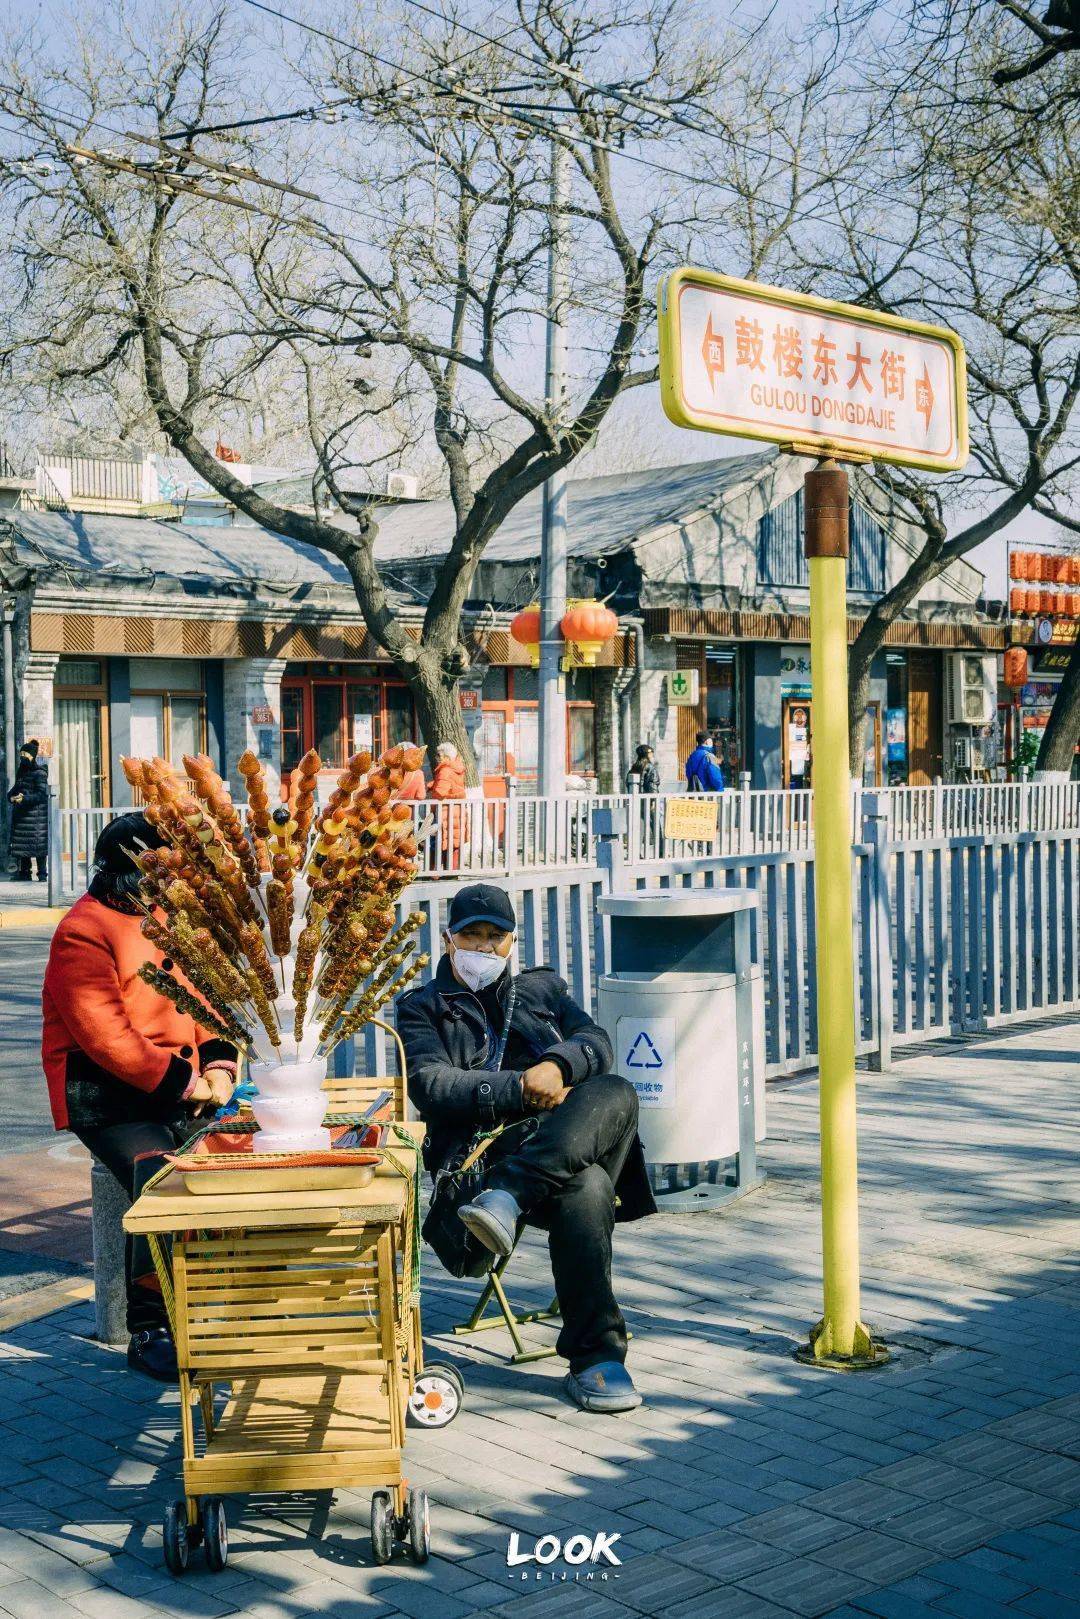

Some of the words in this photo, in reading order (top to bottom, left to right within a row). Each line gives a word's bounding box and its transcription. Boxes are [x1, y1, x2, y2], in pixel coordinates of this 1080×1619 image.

[734, 315, 906, 401] 鼓楼东大街
[750, 383, 806, 414] GULOU
[811, 395, 896, 431] DONGDAJIE
